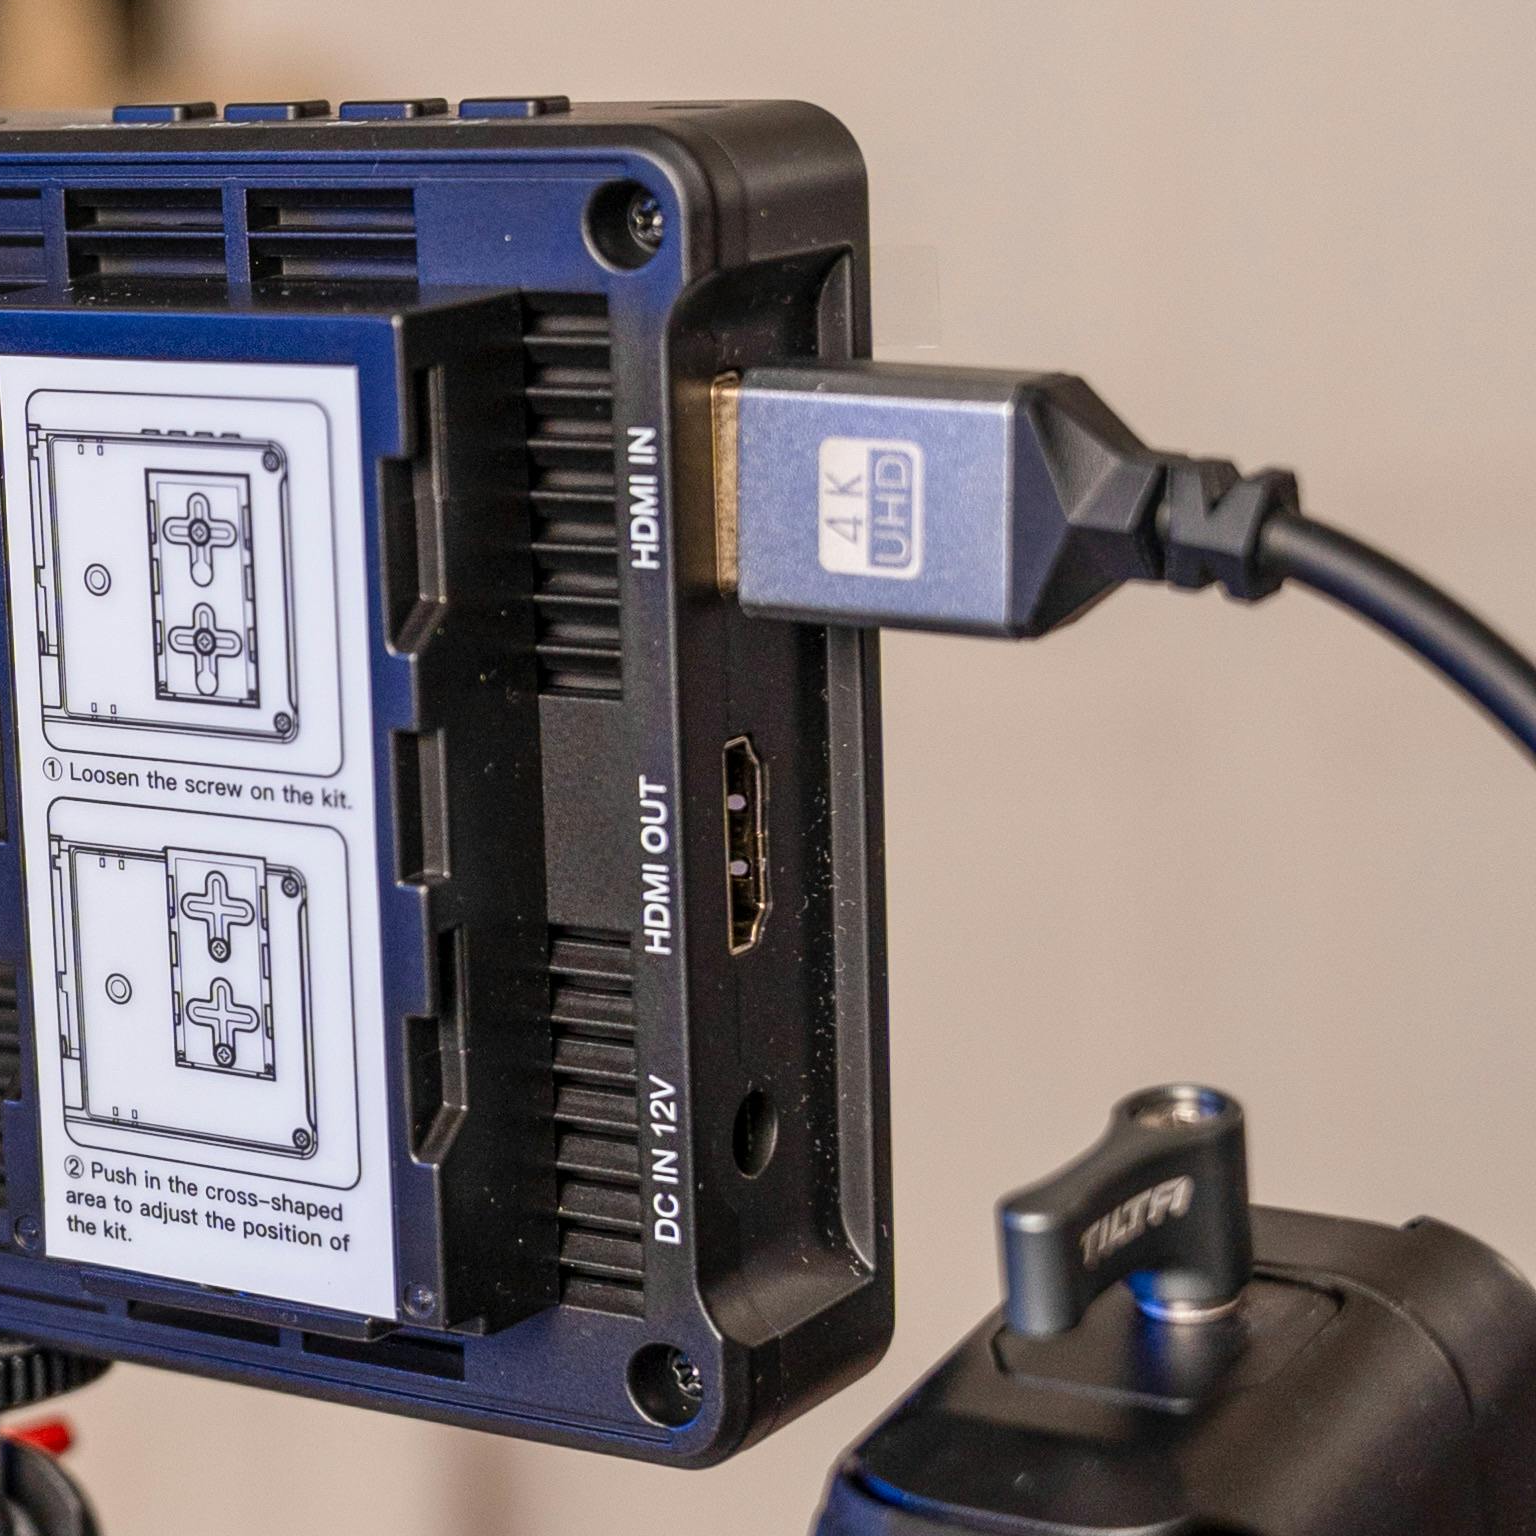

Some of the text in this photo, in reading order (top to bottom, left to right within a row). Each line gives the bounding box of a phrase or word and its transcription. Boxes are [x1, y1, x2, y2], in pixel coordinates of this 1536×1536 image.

[627, 426, 660, 570] HDMI IN
[824, 472, 864, 545] 4K
[874, 455, 910, 564] UHD
[70, 762, 139, 787] Loosen
[147, 770, 177, 791] the
[185, 778, 243, 798] screw
[250, 785, 275, 801] on
[283, 784, 314, 806] the
[321, 788, 353, 810] kit.
[638, 773, 673, 956] HDMI OUT
[91, 1161, 137, 1186] Push
[144, 1169, 161, 1190] in
[168, 1175, 198, 1197] the
[205, 1185, 343, 1222] cross-shaped
[648, 1074, 682, 1246] DC IN 12V
[66, 1189, 351, 1252] area to adjust the position of
[66, 1214, 133, 1242] the kit.
